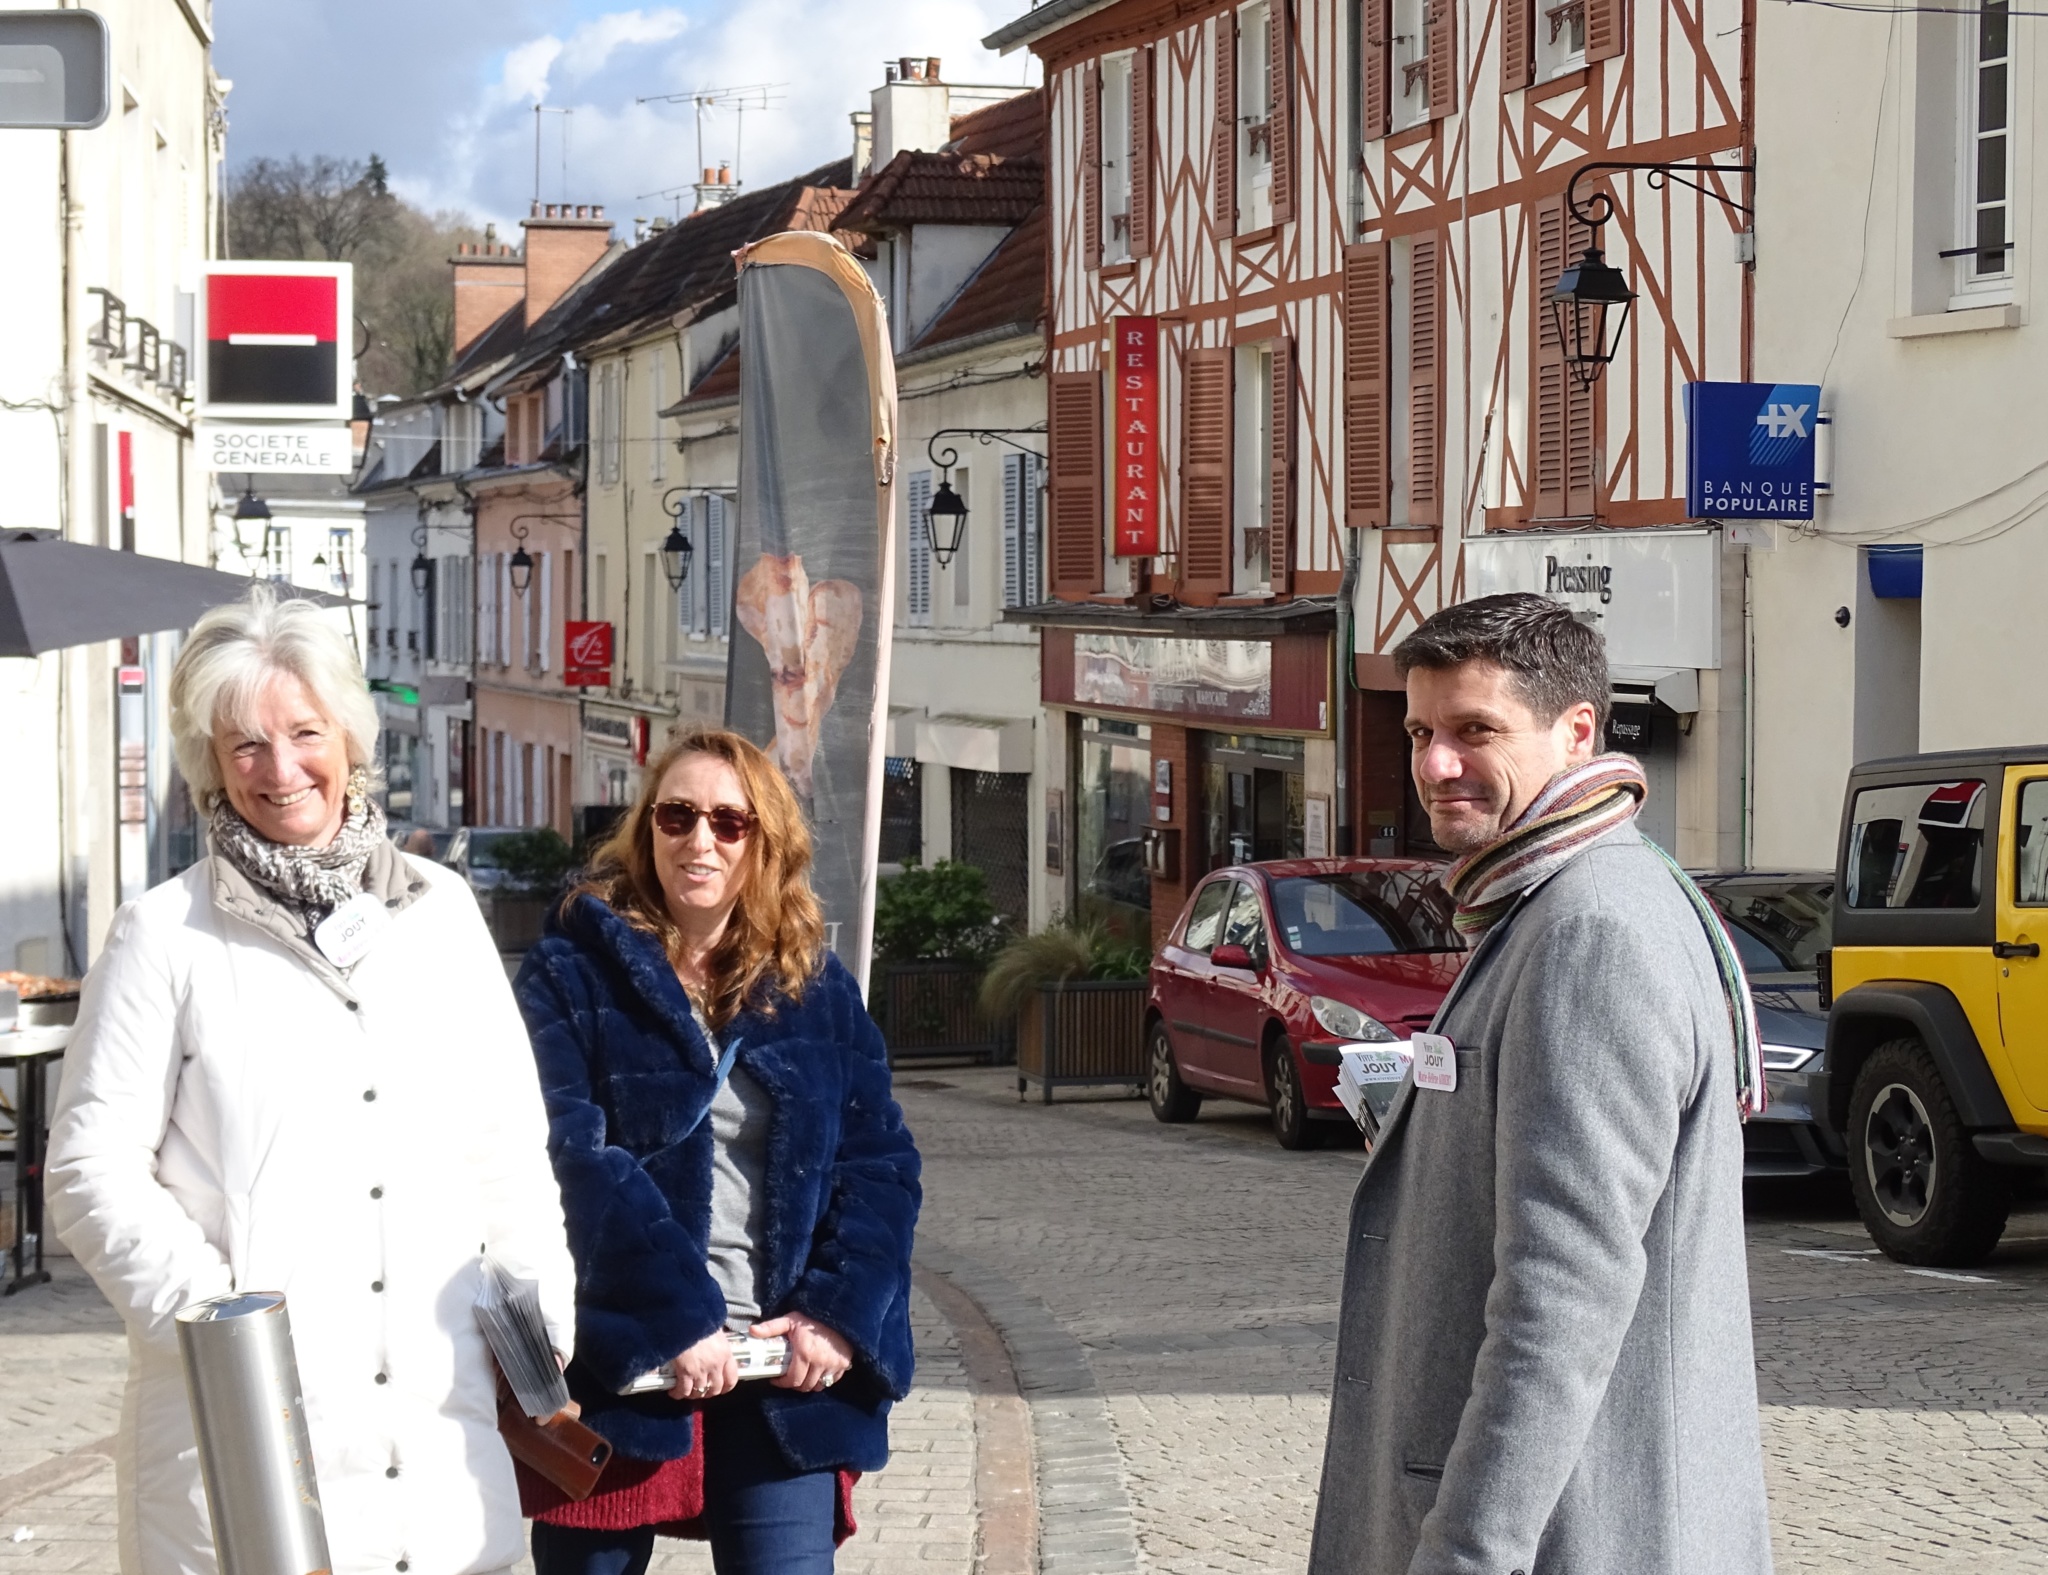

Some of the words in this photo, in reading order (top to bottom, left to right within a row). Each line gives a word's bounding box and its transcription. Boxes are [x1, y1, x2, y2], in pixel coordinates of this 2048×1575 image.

[213, 434, 309, 448] SOCIETE
[1125, 331, 1149, 545] RESTAURANT
[213, 451, 332, 466] GENERALE
[1704, 480, 1808, 496] BANQUE
[1704, 498, 1808, 512] POPULAIRE
[1545, 553, 1612, 604] Pressing
[1383, 827, 1395, 837] 11
[341, 916, 366, 943] JOUY
[1362, 1062, 1397, 1074] JOUY
[1424, 1055, 1444, 1067] JOUY
